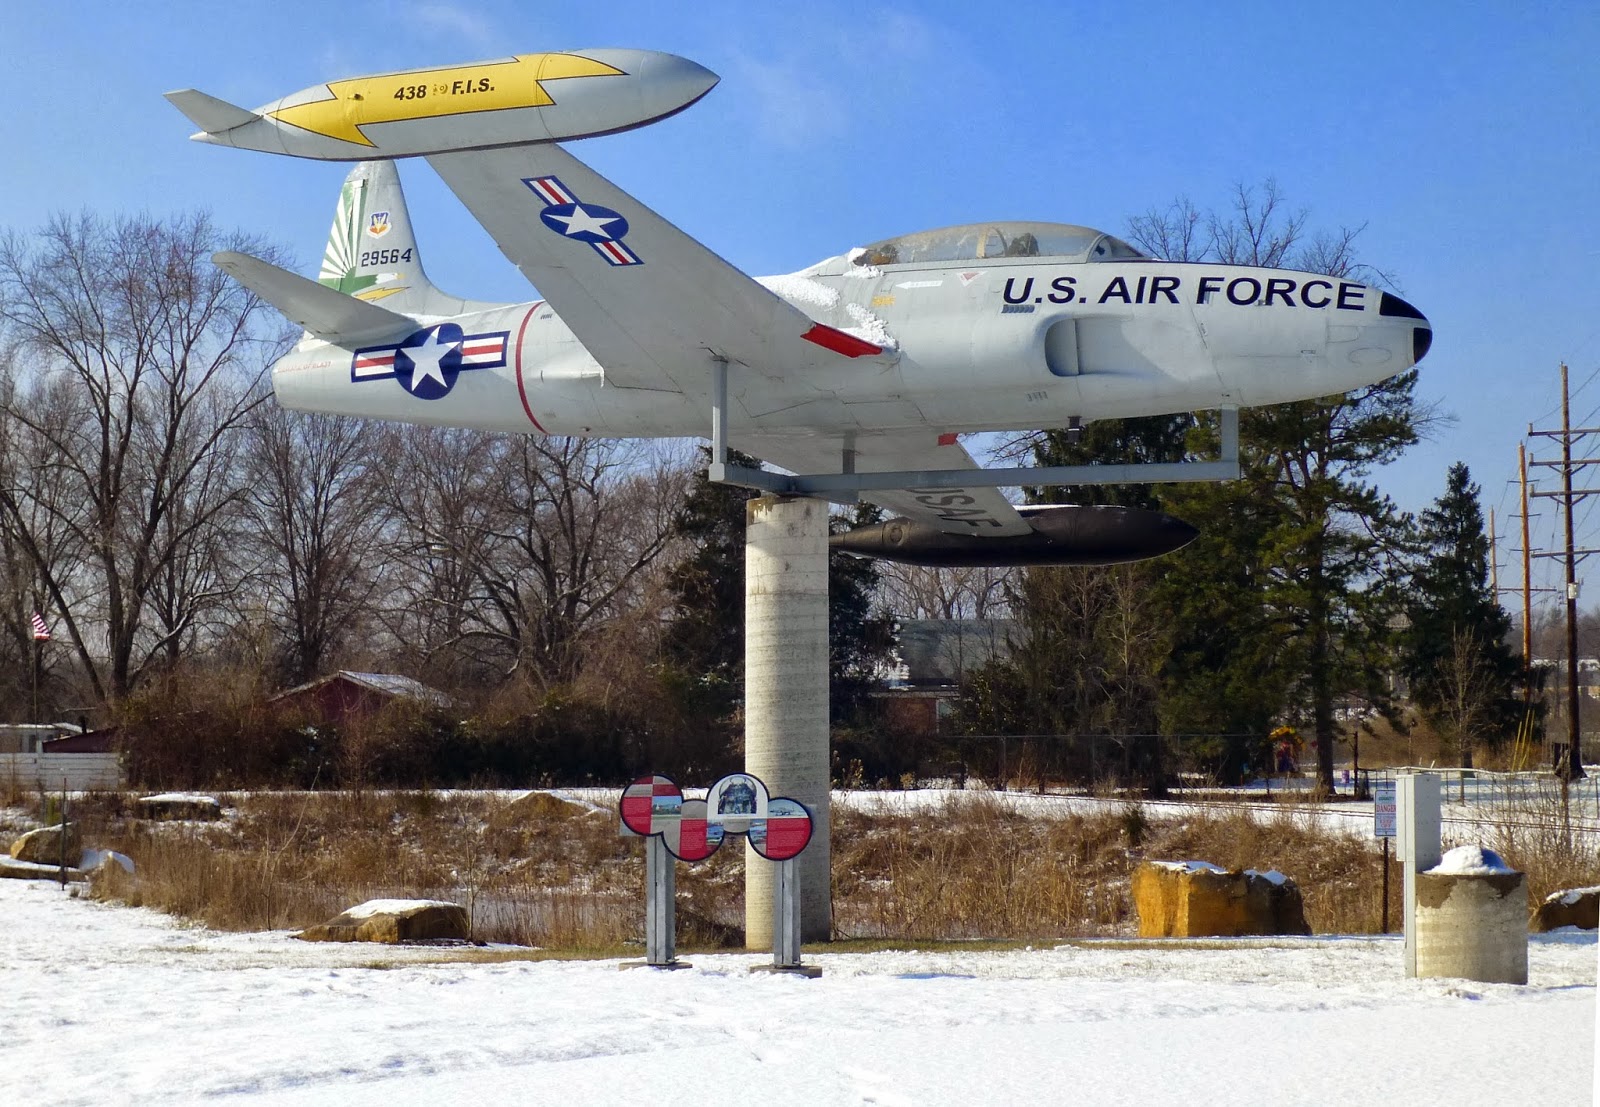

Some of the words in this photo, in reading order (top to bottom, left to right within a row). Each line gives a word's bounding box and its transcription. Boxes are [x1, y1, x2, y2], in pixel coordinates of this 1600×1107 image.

[394, 85, 427, 101] 438
[452, 78, 495, 96] F.I.S.
[361, 248, 413, 267] 29564
[1002, 276, 1087, 304] U.S.
[1098, 276, 1181, 304] AIR
[1196, 276, 1367, 311] FORCE
